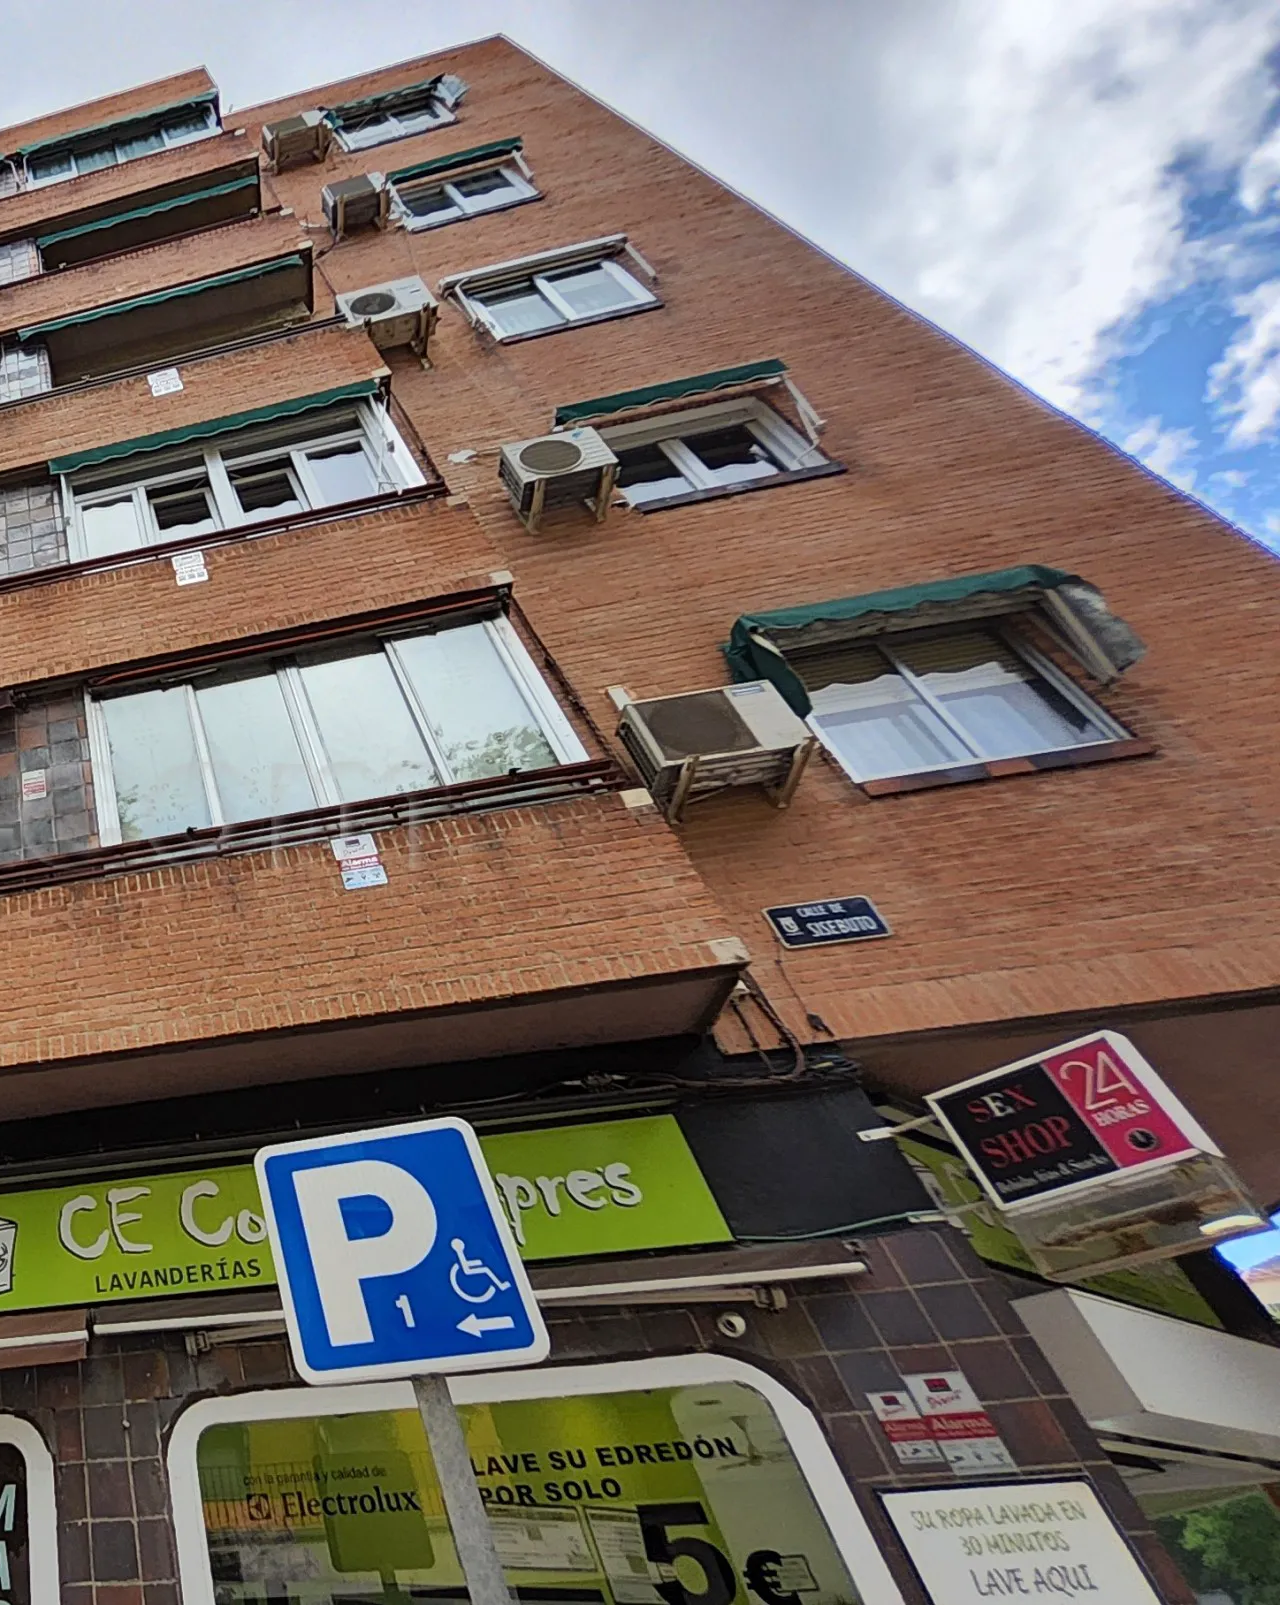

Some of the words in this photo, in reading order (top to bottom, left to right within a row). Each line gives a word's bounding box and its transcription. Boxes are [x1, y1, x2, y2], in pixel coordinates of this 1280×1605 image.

[796, 904, 829, 918] CALLE
[827, 902, 848, 914] DE
[805, 915, 879, 938] SISEBUTO
[1059, 1050, 1140, 1111] 24
[966, 1083, 1038, 1124] SEX
[1091, 1098, 1152, 1128] HORAS
[978, 1115, 1074, 1169] SHOP
[58, 1186, 154, 1260] CE
[179, 1179, 269, 1248] Co
[495, 1162, 644, 1247] pres
[291, 1159, 438, 1348] P
[95, 1257, 262, 1294] LAVANDERÍAS
[395, 1294, 416, 1328] 1
[470, 1453, 542, 1477] LAVE
[548, 1447, 588, 1472] SU
[597, 1434, 740, 1468] EDREDÓN
[331, 1465, 370, 1482] calidad
[371, 1466, 388, 1478] de
[279, 1485, 423, 1519] Electrolux
[478, 1483, 538, 1506] POR
[545, 1476, 623, 1502] SOLO
[910, 1509, 938, 1531] SU
[936, 1504, 990, 1530] ROPA
[986, 1500, 1058, 1525] LAVADA
[1057, 1499, 1088, 1521] EN
[958, 1534, 984, 1556] 30
[984, 1529, 1071, 1556] MINUTOS
[969, 1566, 1030, 1597] LAVE
[1033, 1563, 1100, 1598] AQUI
